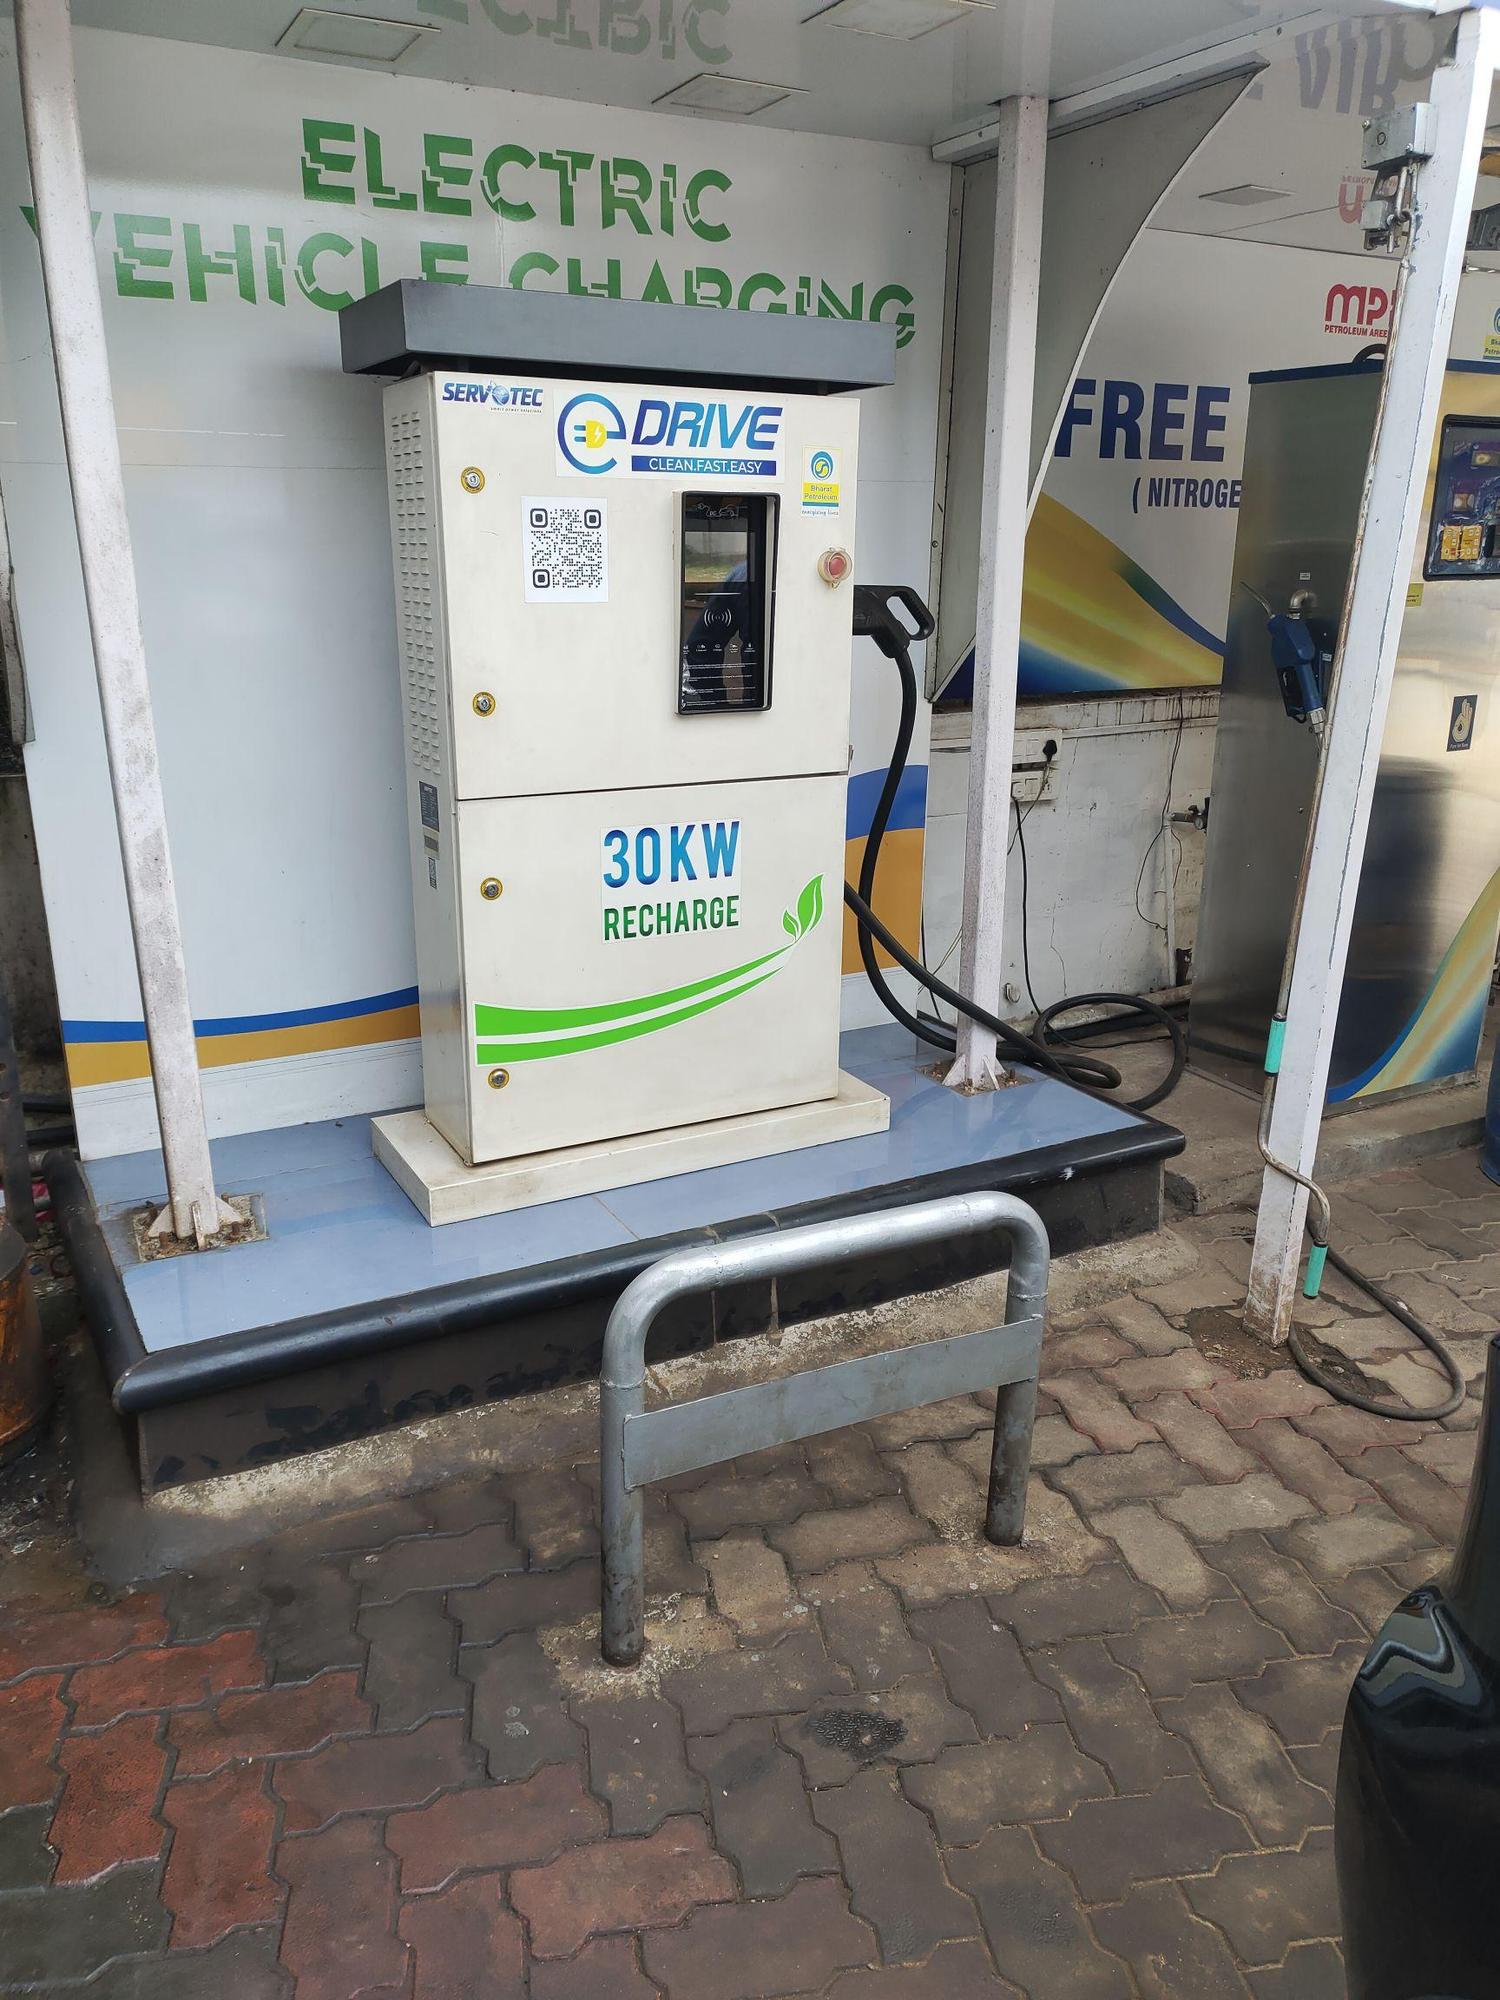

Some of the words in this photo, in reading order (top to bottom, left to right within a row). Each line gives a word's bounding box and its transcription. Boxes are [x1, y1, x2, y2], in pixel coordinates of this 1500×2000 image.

[301, 118, 733, 242] ELECTRIC
[20, 205, 469, 311] EHICLE
[1325, 325, 1367, 336] PETROLEUM
[1369, 329, 1388, 338] AREE
[442, 382, 544, 407] SERVOTEC
[631, 400, 783, 450] DRIVE
[1054, 378, 1230, 462] FREE
[649, 458, 762, 474] CLEAN.FAST.EASY
[811, 484, 833, 492] Bharat
[1148, 478, 1242, 508] NITROGE
[603, 821, 740, 888] 30KW
[604, 895, 740, 941] RECHARGE
